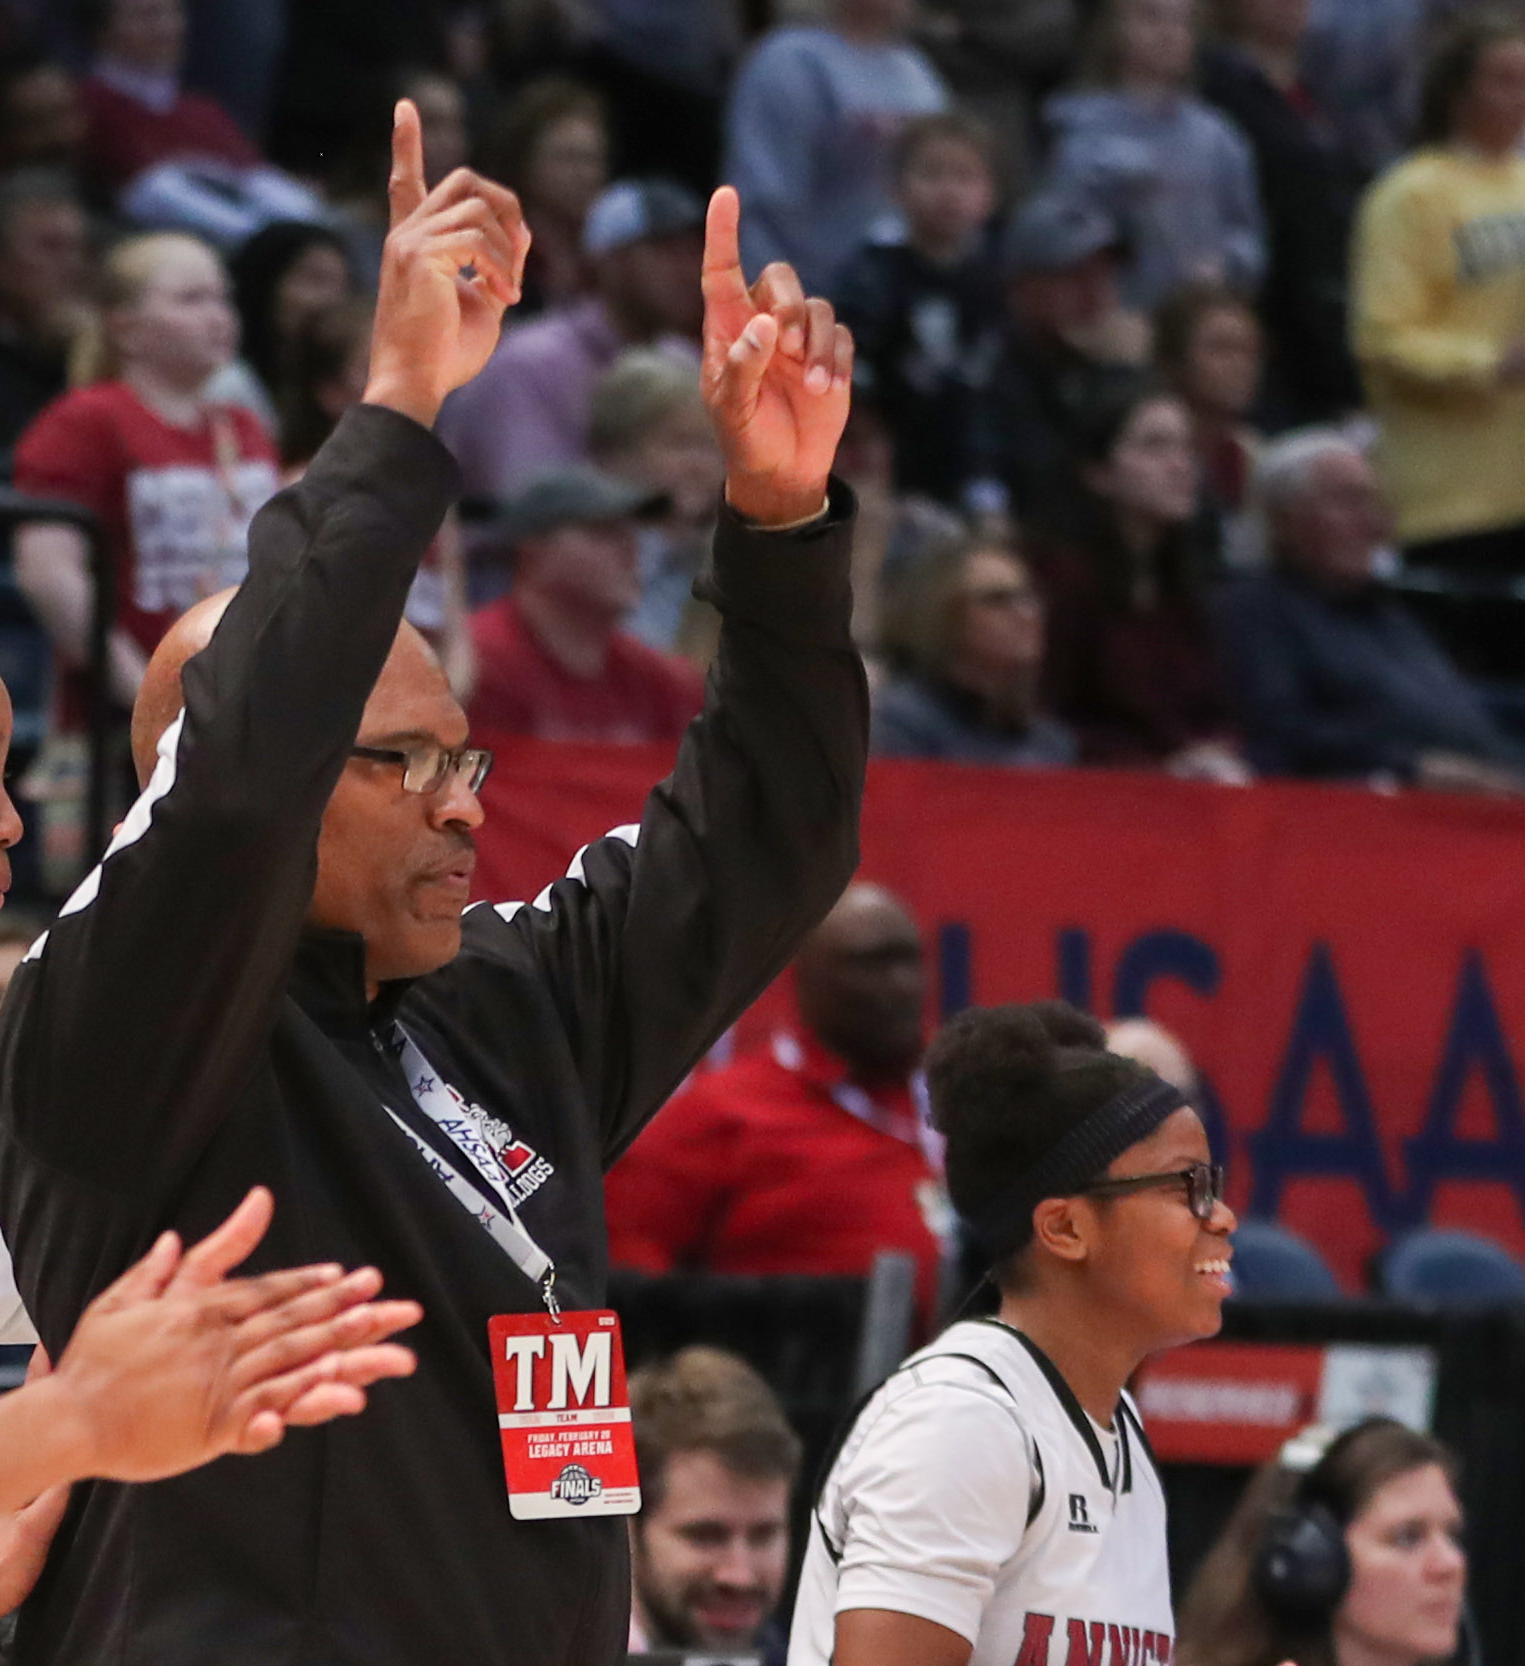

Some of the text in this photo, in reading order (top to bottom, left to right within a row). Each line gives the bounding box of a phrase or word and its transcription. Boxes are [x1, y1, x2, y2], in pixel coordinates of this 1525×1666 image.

[505, 1331, 612, 1411] TM
[556, 1412, 578, 1423] TEAM
[559, 1430, 598, 1442] FEBRUARY
[528, 1440, 614, 1459] LEGACY ARENA
[550, 1477, 602, 1500] FINALS
